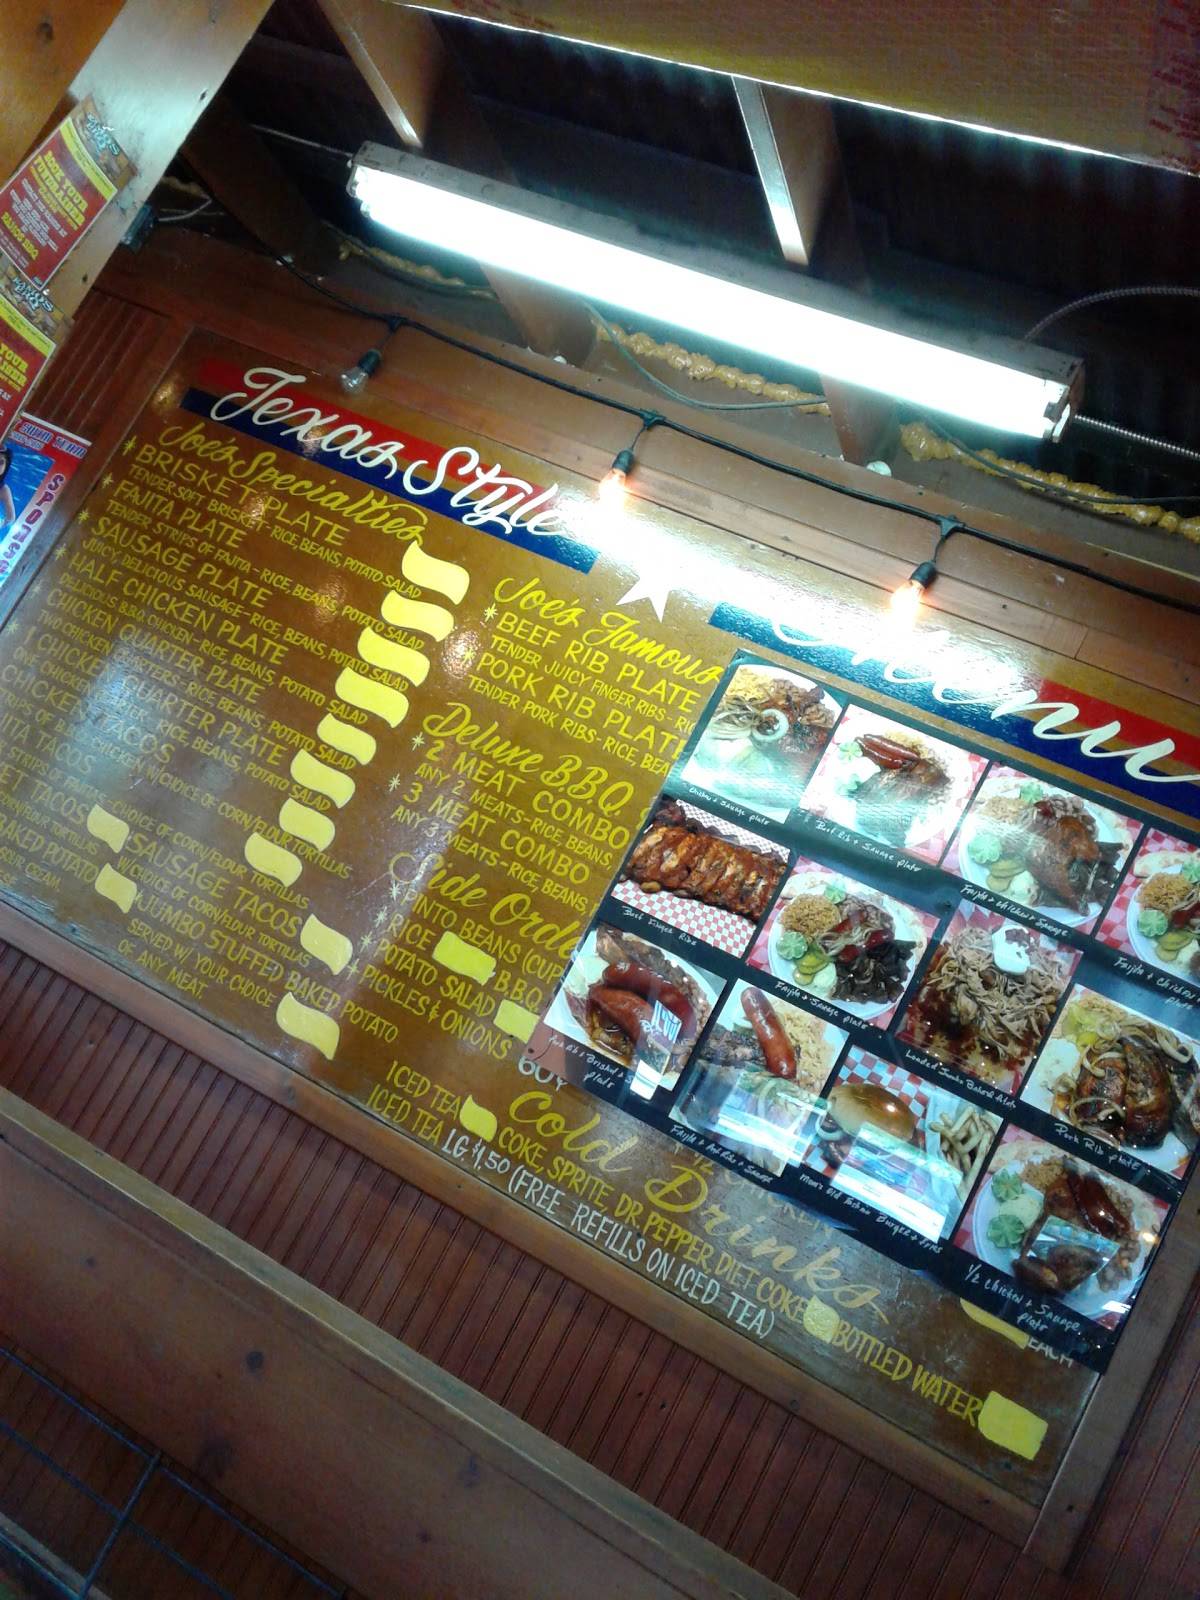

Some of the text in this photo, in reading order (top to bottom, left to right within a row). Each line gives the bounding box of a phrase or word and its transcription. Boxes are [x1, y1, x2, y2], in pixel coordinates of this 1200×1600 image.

[134, 442, 351, 548] BRISKET PLATE
[161, 423, 429, 545] Joe's Specialties
[210, 366, 405, 480] Texas
[402, 446, 574, 536] Style
[89, 514, 272, 609] SAUSAGE PLATE
[112, 478, 247, 550] FAJITA PLATE
[125, 464, 176, 493] TENDER
[173, 485, 205, 506] SOFT
[380, 574, 423, 600] SALAD
[66, 551, 289, 667] HALF CHICKEN PLATE
[103, 499, 426, 652] TENDER STRIPS OF POTATO SALAD
[120, 553, 186, 592] DELICIOUS
[326, 647, 370, 676] POTATO
[368, 666, 410, 693] SALAD
[43, 586, 265, 705] CHICKEN QUARTER PLATE
[486, 633, 636, 709] TENDER JUICY FINGER
[494, 577, 725, 686] Joe's Famous
[495, 610, 701, 714] BEEF RIB PLATE
[0, 662, 177, 765] CHICKEN TACOS
[33, 629, 288, 767] CHICKEN QUARTER PLATE
[37, 659, 95, 696] CHICKEN
[243, 761, 290, 793] POTATO
[287, 783, 332, 814] SALAD
[59, 620, 115, 655] CHICKEN
[266, 719, 317, 753] POTATO
[314, 743, 357, 773] SALAD
[276, 675, 327, 708] POTATO
[325, 698, 369, 728] SALAD
[463, 674, 560, 727] TENDER PORK
[473, 651, 545, 697] PORK
[545, 683, 599, 722] RIB
[414, 761, 466, 796] ANY 2
[422, 702, 544, 776] Deluxe
[390, 804, 440, 839] ANY 3
[401, 779, 594, 888] 3 MEAT COMBO
[423, 737, 633, 852] 2 MEAT COMBO
[40, 840, 102, 886] POTATO
[125, 830, 304, 939] SAUSAGE TACOS
[247, 869, 311, 912] TORTILLAS
[289, 839, 353, 881] TORTILLAS
[115, 937, 137, 959] OF
[135, 949, 167, 975] ANY
[125, 916, 175, 953] SERVED
[190, 952, 231, 985] YOUR
[226, 971, 276, 1011] CHOICE
[135, 889, 400, 1045] JUMBO STUFFED BAKED POTATO
[384, 912, 436, 952] RICE
[398, 887, 460, 930] PINTO
[457, 917, 524, 964] BEANS
[357, 964, 432, 1018] PICKLES
[437, 1006, 514, 1063] ONIONS
[371, 937, 498, 1019] POTATO SALAD
[364, 1084, 413, 1126] ICED
[406, 1108, 446, 1145] TEA
[504, 1163, 567, 1217] (FREE
[568, 1201, 649, 1265] REFILLS
[643, 1245, 677, 1282] ON
[671, 1262, 723, 1308] ICED
[719, 1289, 778, 1341] TEA)
[383, 1059, 433, 1102] ICED
[423, 1083, 466, 1121] TEA
[827, 1318, 915, 1386] BOTTLED
[907, 1363, 987, 1427] WATER
[507, 1090, 641, 1178] Cold
[644, 1165, 888, 1323] Drinks
